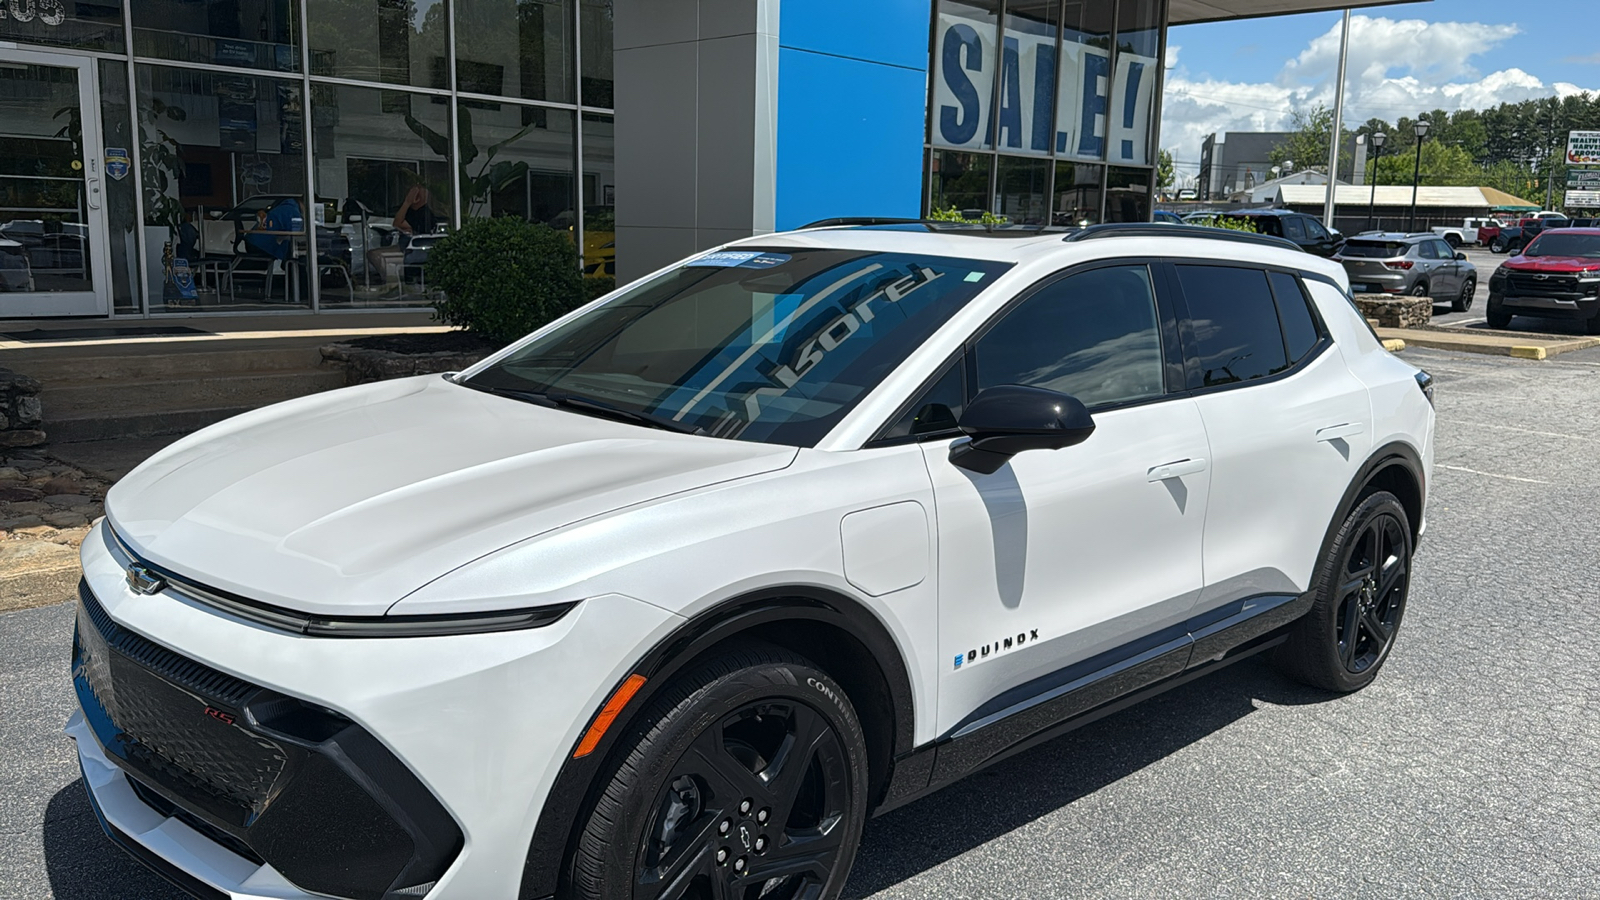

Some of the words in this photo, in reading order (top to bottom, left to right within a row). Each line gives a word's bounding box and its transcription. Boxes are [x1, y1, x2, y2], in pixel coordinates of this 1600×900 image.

[940, 23, 1144, 159] SALE!
[954, 628, 1039, 667] EQUINOX
[204, 706, 236, 724] RS
